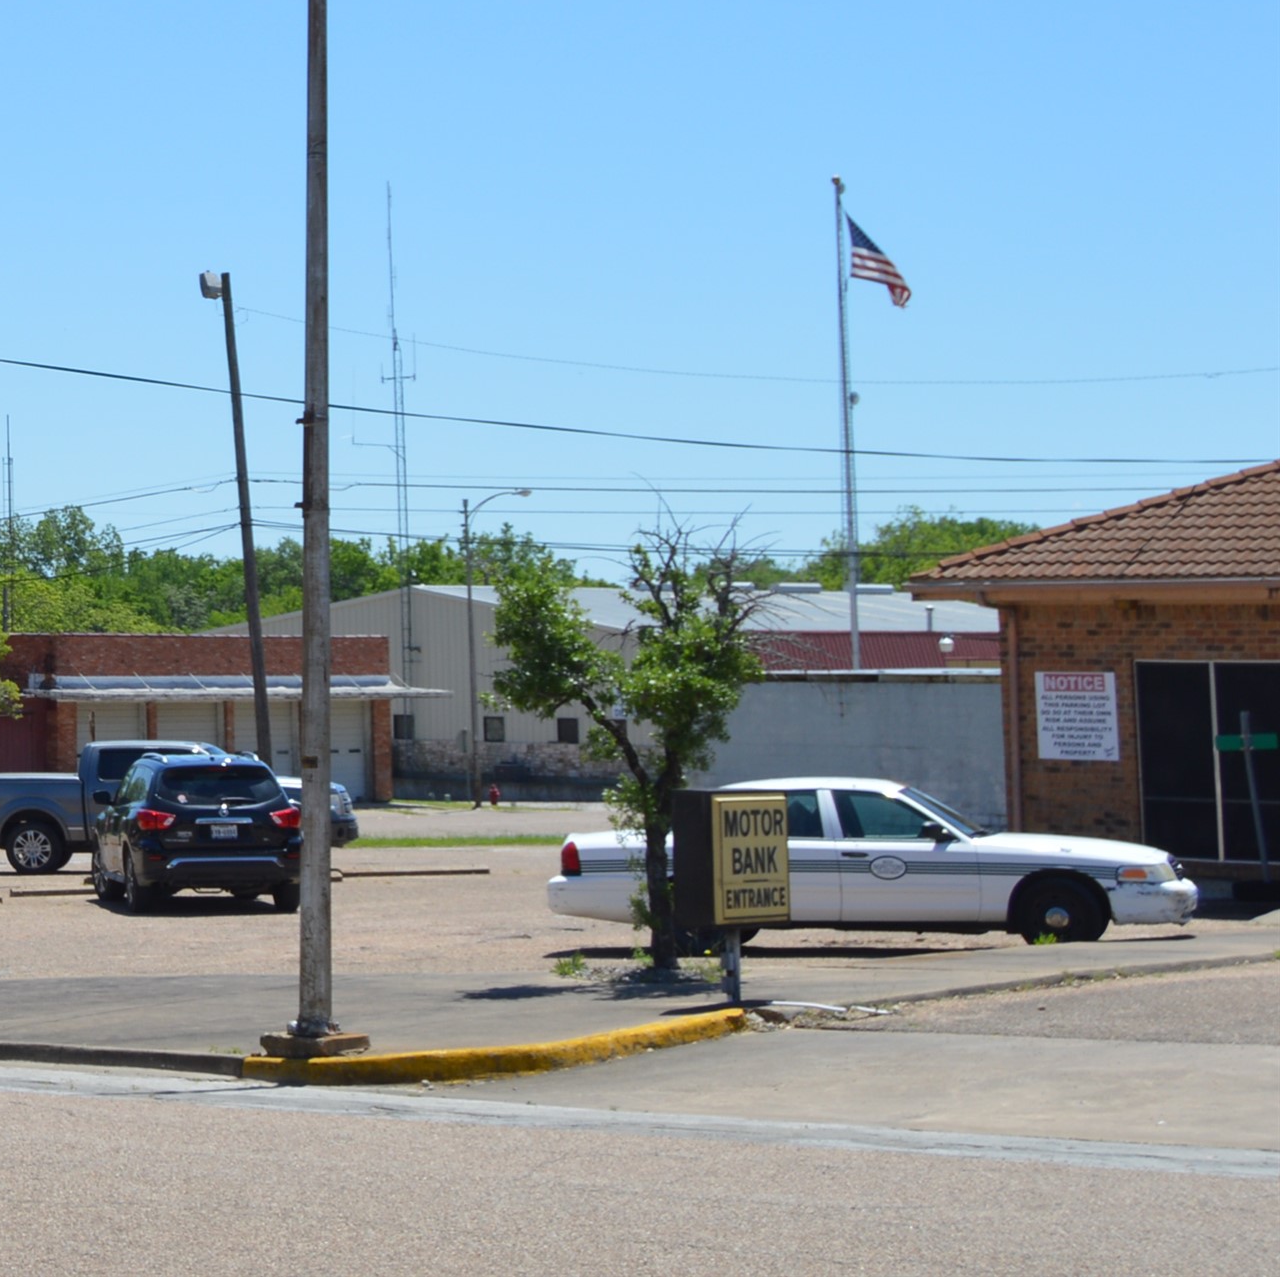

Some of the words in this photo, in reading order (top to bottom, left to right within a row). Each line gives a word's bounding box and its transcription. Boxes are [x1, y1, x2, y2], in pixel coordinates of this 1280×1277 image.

[1045, 676, 1104, 690] NOTICE
[724, 809, 784, 837] MOTOR
[732, 846, 778, 875] BANK
[726, 887, 787, 909] ENTRANCE
